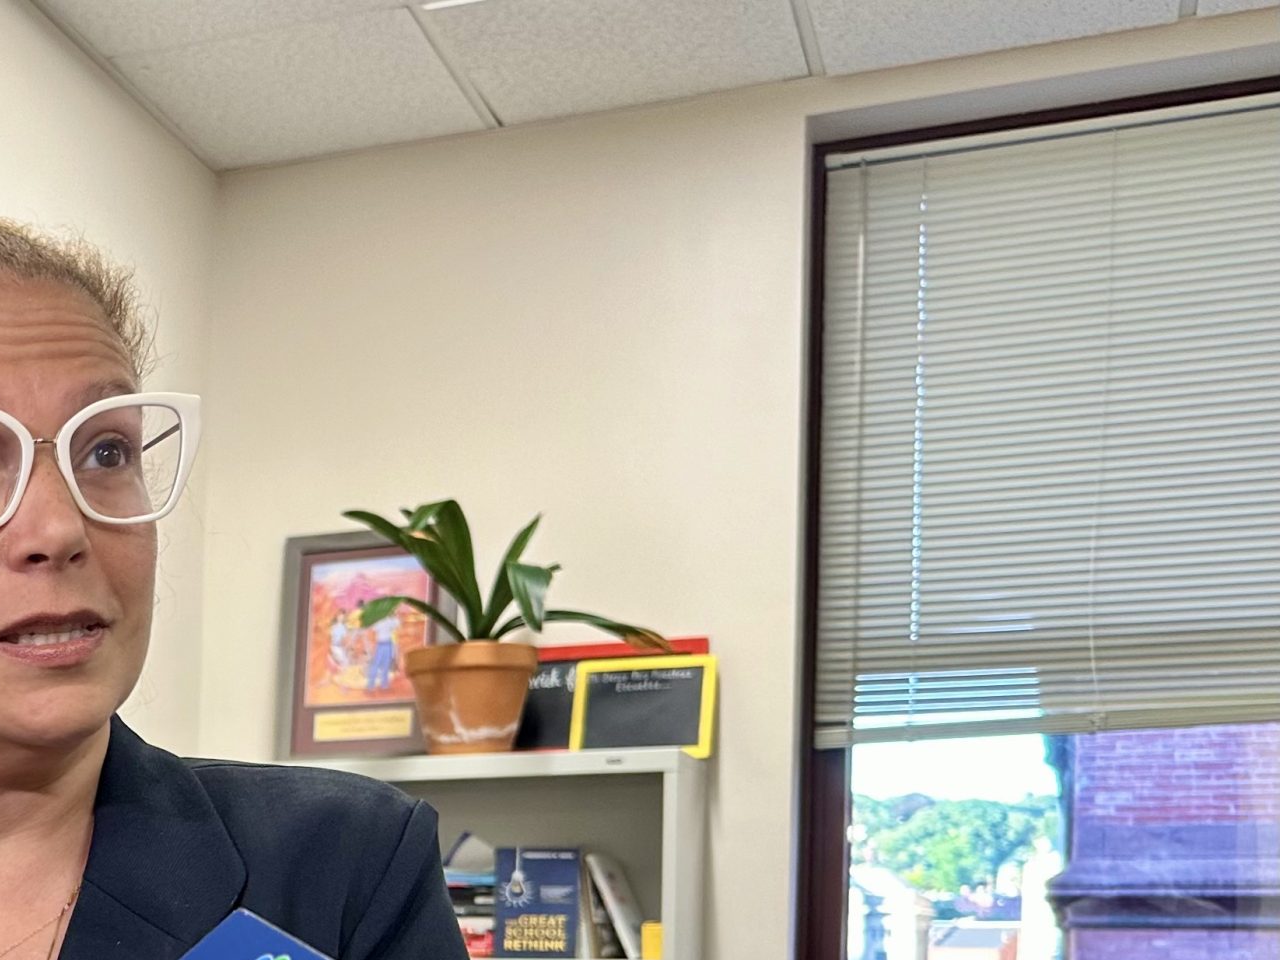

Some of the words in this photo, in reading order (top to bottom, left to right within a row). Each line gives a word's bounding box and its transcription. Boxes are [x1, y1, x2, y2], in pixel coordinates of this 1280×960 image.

[518, 914, 568, 928] GREAT
[505, 926, 567, 941] SCHOOL
[504, 939, 567, 953] RETHINK
